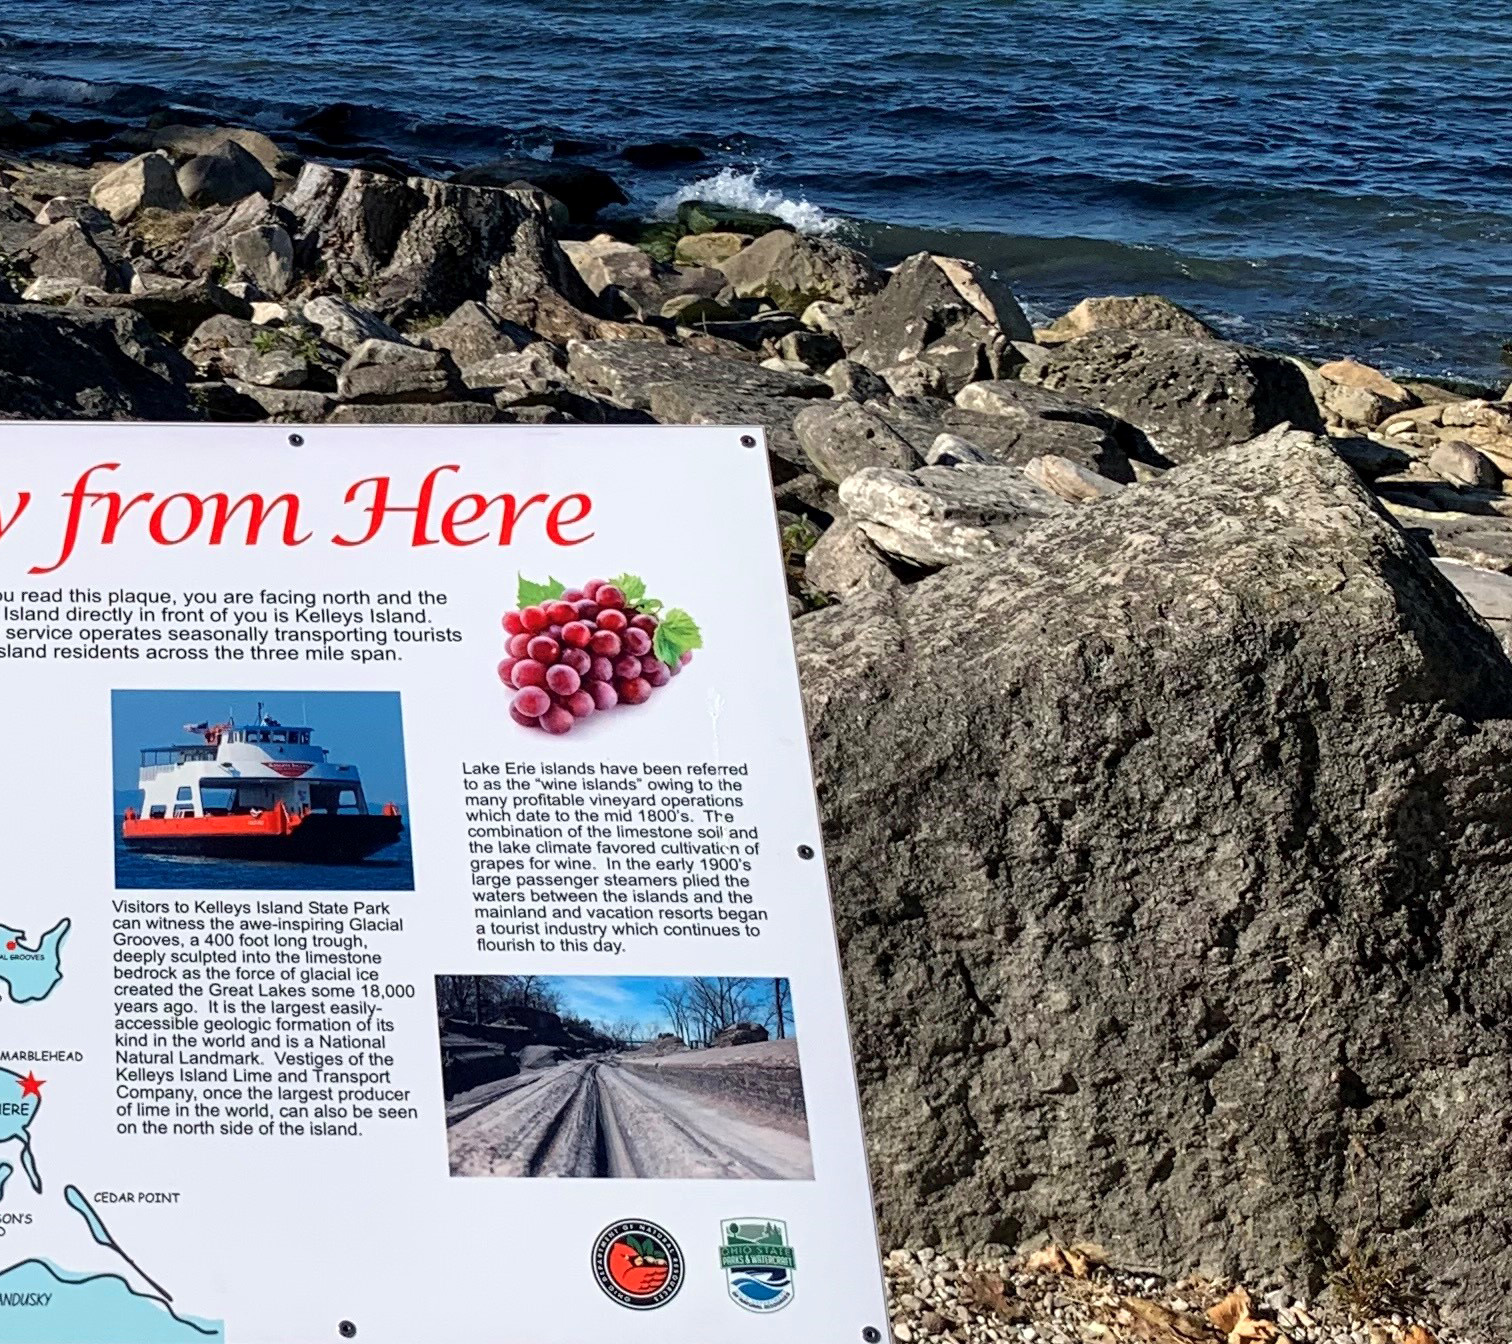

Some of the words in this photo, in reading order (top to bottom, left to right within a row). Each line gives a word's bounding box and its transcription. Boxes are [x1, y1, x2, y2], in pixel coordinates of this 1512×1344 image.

[28, 462, 312, 575] from
[331, 464, 593, 548] Here
[21, 588, 63, 603] read
[69, 588, 102, 603] this
[108, 588, 177, 607] plaque,
[183, 592, 217, 608] you
[223, 592, 254, 605] are
[259, 589, 316, 609] facing
[322, 589, 371, 605] north
[377, 590, 412, 605] and
[418, 590, 448, 605] the
[4, 606, 59, 622] Island
[65, 606, 134, 626] directly
[139, 606, 155, 622] in
[161, 606, 205, 623] front
[209, 607, 229, 623] of
[233, 611, 267, 627] you
[273, 607, 289, 623] is
[295, 608, 364, 628] Kelleys
[370, 608, 432, 624] Island.
[462, 762, 500, 775] Lake
[505, 761, 536, 775] Erie
[540, 762, 596, 775] islands
[599, 762, 638, 775] have
[642, 762, 682, 776] been
[687, 762, 748, 776] referred
[465, 808, 511, 822] which
[515, 809, 551, 822] date
[554, 809, 570, 822] to
[574, 809, 599, 822] the
[604, 809, 633, 823] mid
[638, 809, 694, 823] 1800's.
[702, 809, 734, 823] The
[470, 859, 525, 873] grapes
[529, 856, 551, 870] for
[554, 856, 597, 870] wine.
[606, 857, 621, 870] In
[625, 857, 651, 871] the
[655, 857, 695, 874] early
[700, 857, 752, 872] 1900's
[111, 899, 170, 914] Visitors
[174, 900, 190, 914] to
[194, 900, 252, 918] Kelleys
[256, 900, 303, 915] Island
[308, 900, 349, 915] State
[353, 901, 391, 915] Park
[475, 924, 486, 935] a
[490, 921, 541, 935] tourist
[544, 921, 607, 940] industry
[611, 922, 659, 936] which
[663, 922, 741, 937] continues
[744, 923, 761, 937] to
[113, 932, 185, 948] Grooves,
[189, 936, 200, 947] a
[204, 932, 234, 947] 400
[238, 933, 270, 947] foot
[274, 933, 308, 951] long
[312, 934, 368, 951] trough,
[114, 982, 174, 997] created
[178, 982, 203, 997] the
[208, 982, 254, 997] Great
[258, 983, 307, 998] Lakes
[311, 986, 355, 998] some
[361, 983, 416, 1000] 18,000
[116, 1050, 174, 1065] Natural
[179, 1050, 265, 1066] Landmark.
[274, 1051, 344, 1070] Vestiges
[348, 1051, 365, 1066] of
[368, 1052, 394, 1067] the
[116, 1102, 133, 1117] of
[137, 1102, 171, 1117] lime
[175, 1102, 190, 1117] in
[194, 1102, 220, 1118] the
[224, 1103, 274, 1120] world,
[279, 1106, 309, 1118] can
[314, 1103, 348, 1119] also
[352, 1104, 373, 1119] be
[378, 1107, 418, 1119] seen
[94, 1192, 135, 1204] CEDAR
[138, 1192, 180, 1204] POINT
